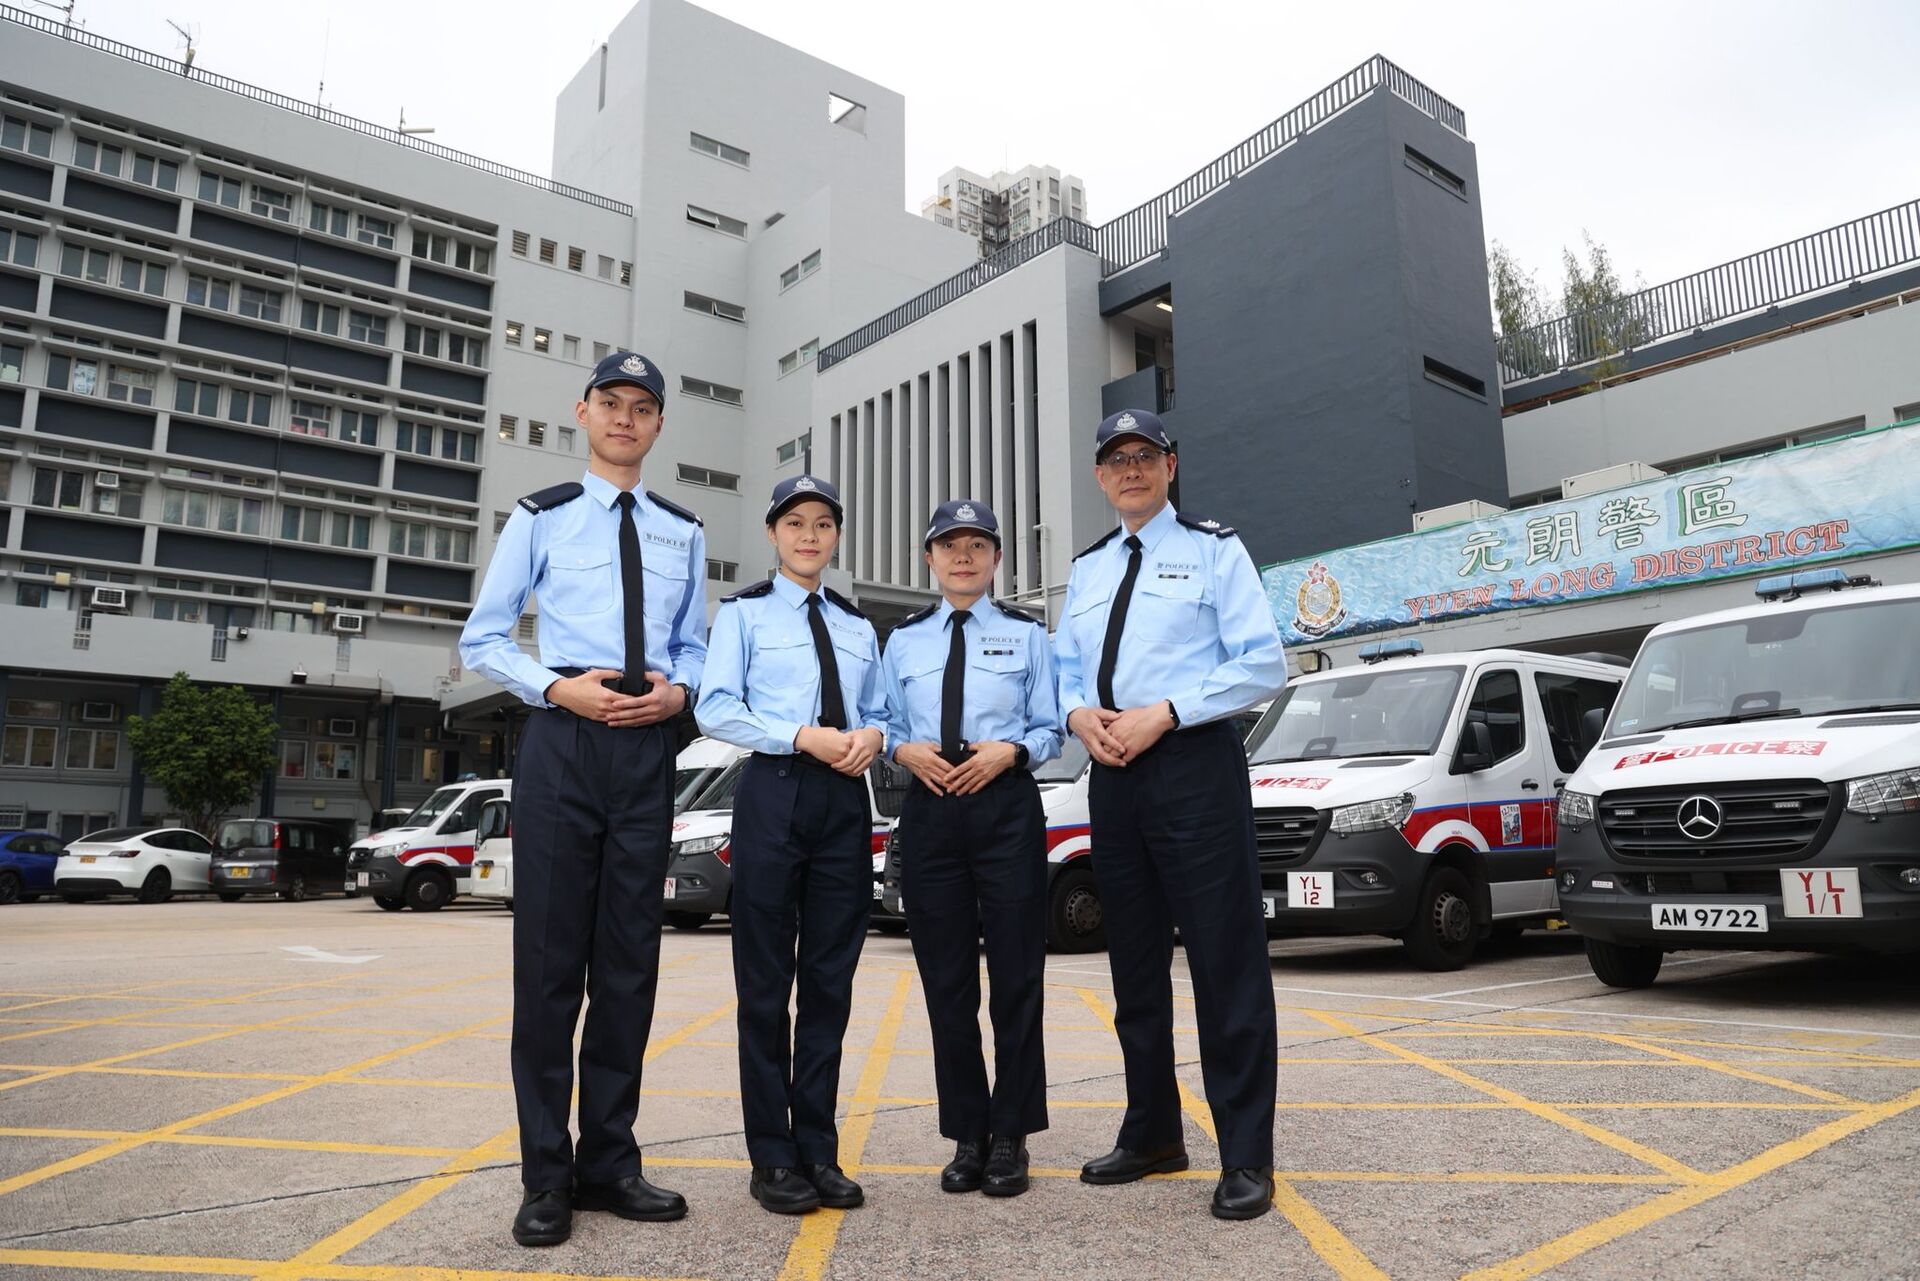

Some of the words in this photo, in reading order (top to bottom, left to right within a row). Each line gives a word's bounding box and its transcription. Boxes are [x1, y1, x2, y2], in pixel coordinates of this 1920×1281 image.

[1458, 476, 1748, 577] 元朗警區
[653, 536, 677, 546] POLICE
[1405, 584, 1498, 620] YUEN
[1509, 562, 1617, 601] LONG
[1631, 519, 1848, 584] DISTRICT
[1649, 741, 1780, 763] POLICE
[1299, 876, 1322, 889] YL
[1797, 871, 1846, 893] YL
[1303, 892, 1320, 905] 12
[1805, 893, 1842, 915] 1/1
[1659, 907, 1688, 927] AM
[1694, 909, 1759, 928] 9722
